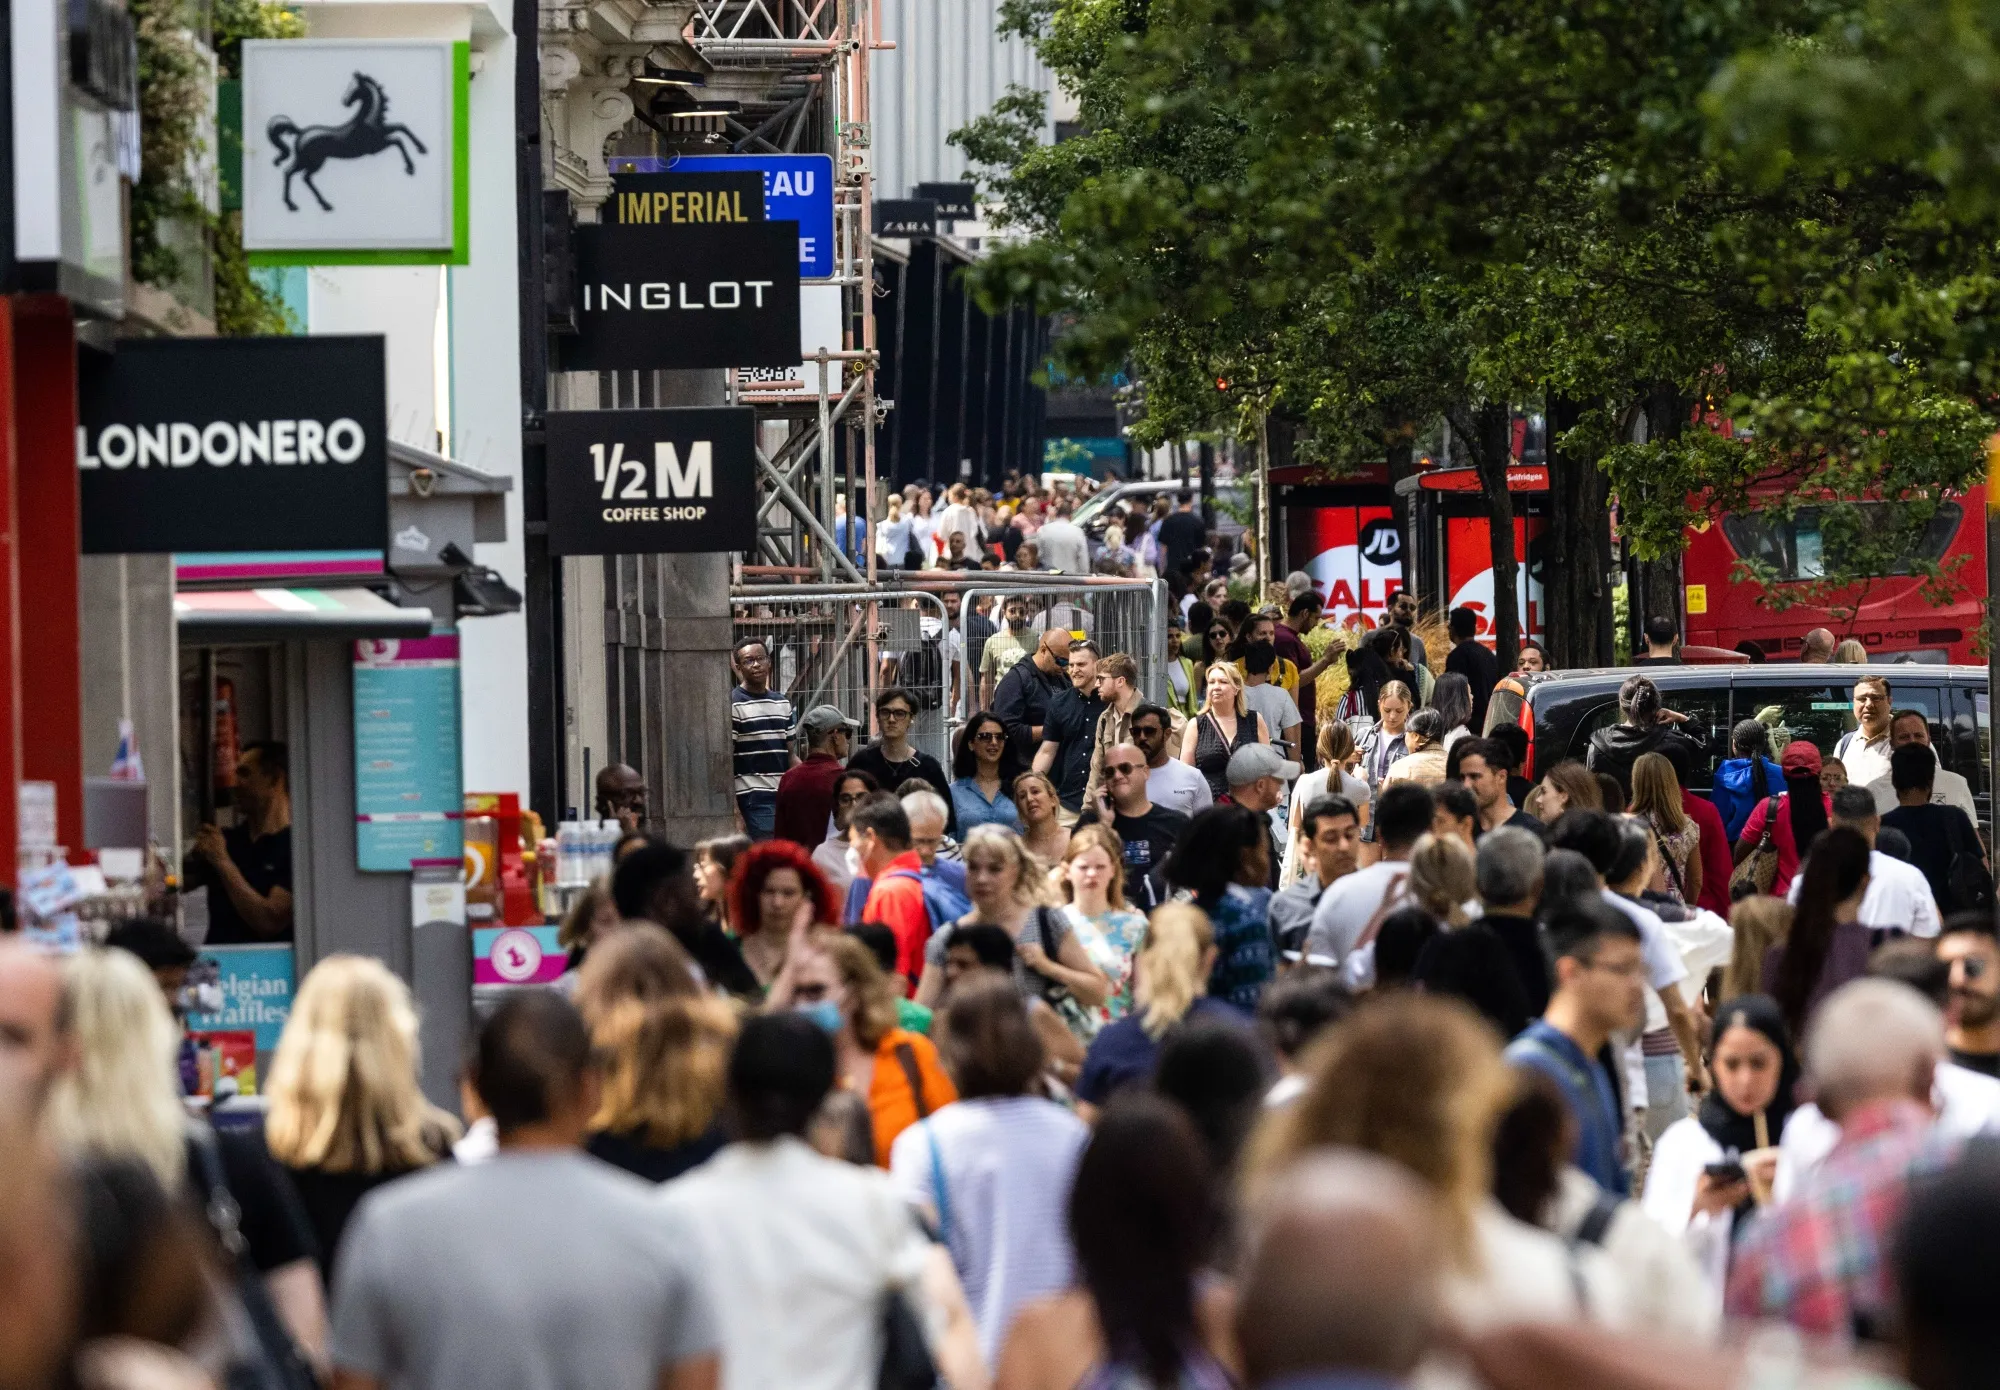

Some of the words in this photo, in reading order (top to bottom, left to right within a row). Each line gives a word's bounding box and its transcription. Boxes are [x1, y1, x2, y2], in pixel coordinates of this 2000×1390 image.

[618, 190, 748, 224] IMPERIAL
[936, 204, 969, 214] ARA
[883, 221, 930, 233] ZARA
[584, 281, 774, 311] INGLOT
[76, 417, 366, 469] LONDONERO
[1507, 473, 1543, 482] Selfridges
[602, 508, 660, 522] COFFEE
[663, 506, 707, 520] SHOP
[1365, 529, 1400, 556] JD
[1885, 629, 1917, 640] 400
[216, 972, 289, 1001] elgian
